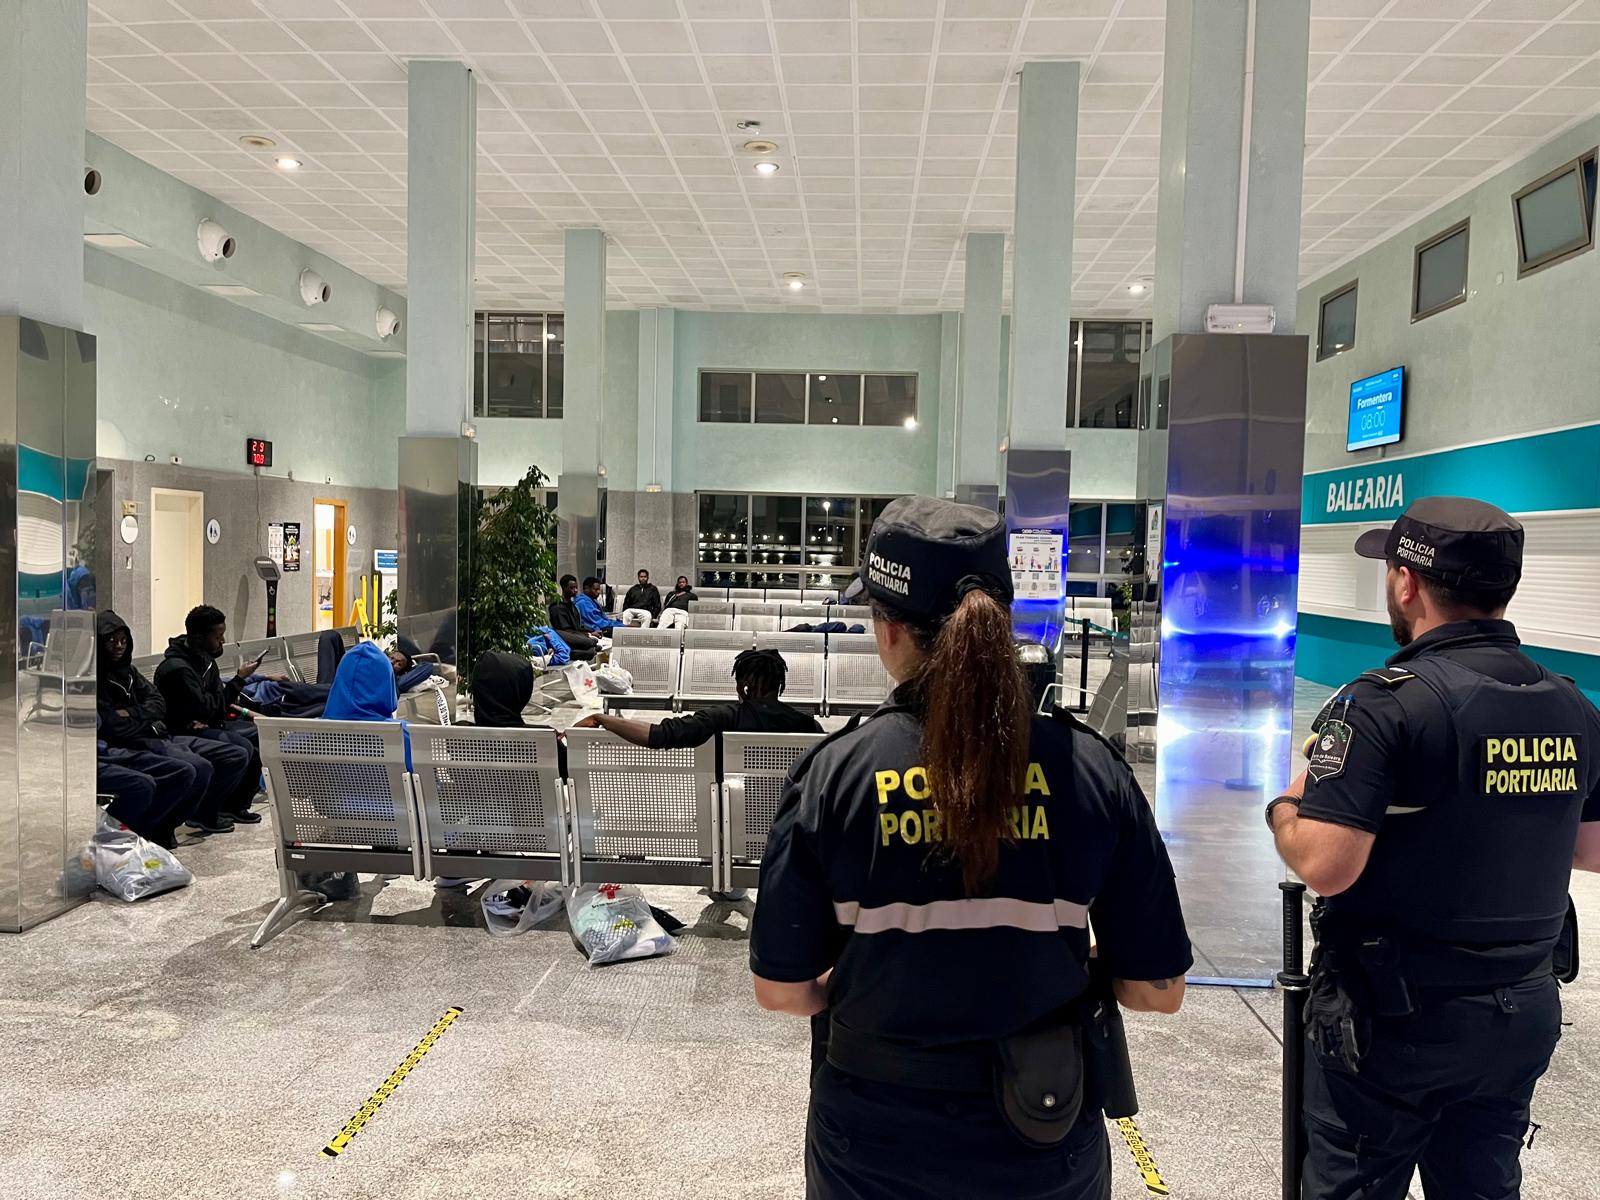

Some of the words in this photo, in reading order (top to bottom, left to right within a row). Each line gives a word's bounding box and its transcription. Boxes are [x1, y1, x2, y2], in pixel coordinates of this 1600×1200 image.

[1357, 391, 1393, 410] Formentera
[1361, 410, 1386, 431] 08:00
[1396, 546, 1433, 568] PORTUARIA
[1399, 535, 1435, 558] POLICIA
[869, 552, 911, 581] POLICIA
[868, 567, 909, 596] PORTUARIA
[1486, 737, 1578, 764] POLICIA
[1485, 767, 1578, 794] PORTUARIA
[343, 1097, 382, 1136] SEGURIDAD
[1120, 1120, 1132, 1130] DE
[1126, 1130, 1153, 1173] SEGURIDAD
